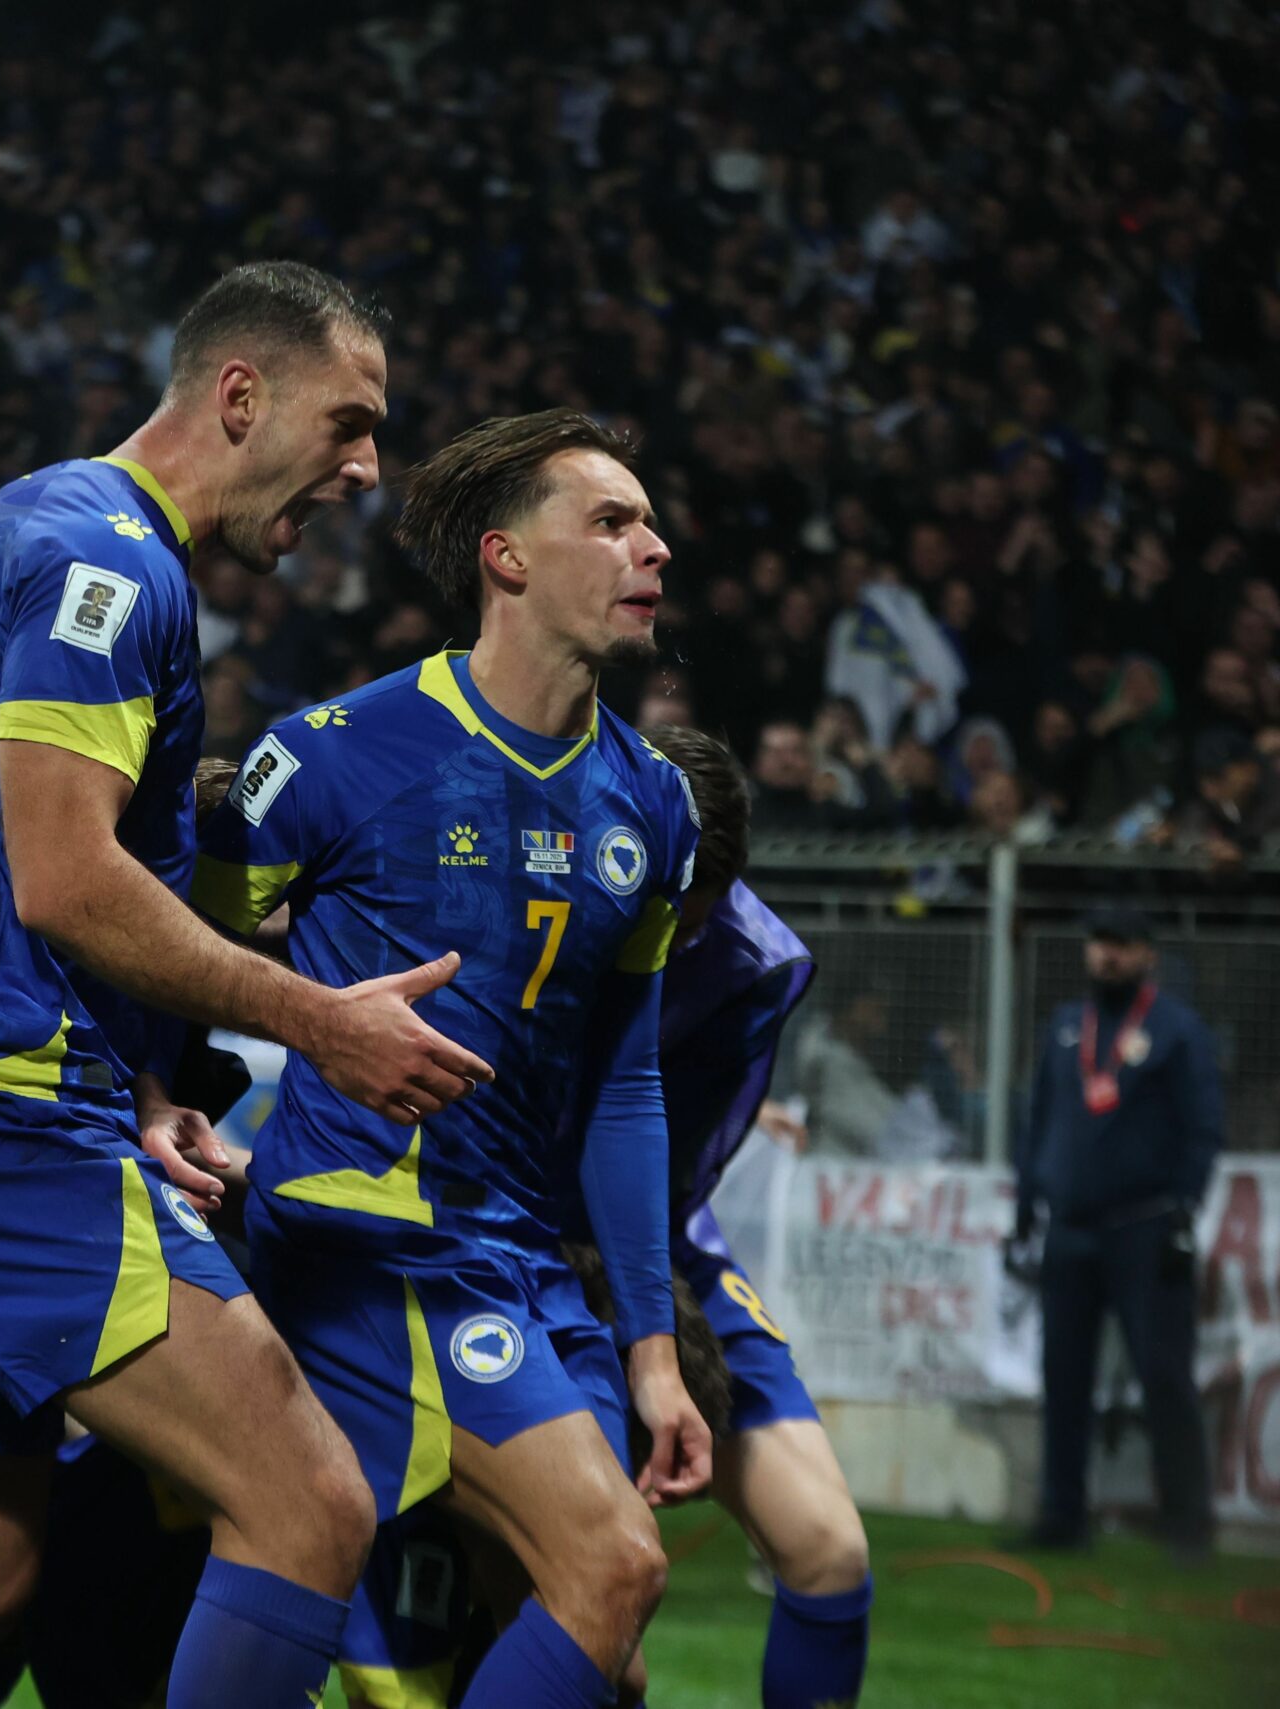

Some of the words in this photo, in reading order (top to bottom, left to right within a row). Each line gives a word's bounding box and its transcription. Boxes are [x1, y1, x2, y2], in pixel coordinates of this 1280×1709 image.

[82, 616, 97, 627] FIFA
[71, 625, 100, 638] QUALIFIERS
[439, 856, 488, 866] KELME
[521, 900, 571, 1009] 7
